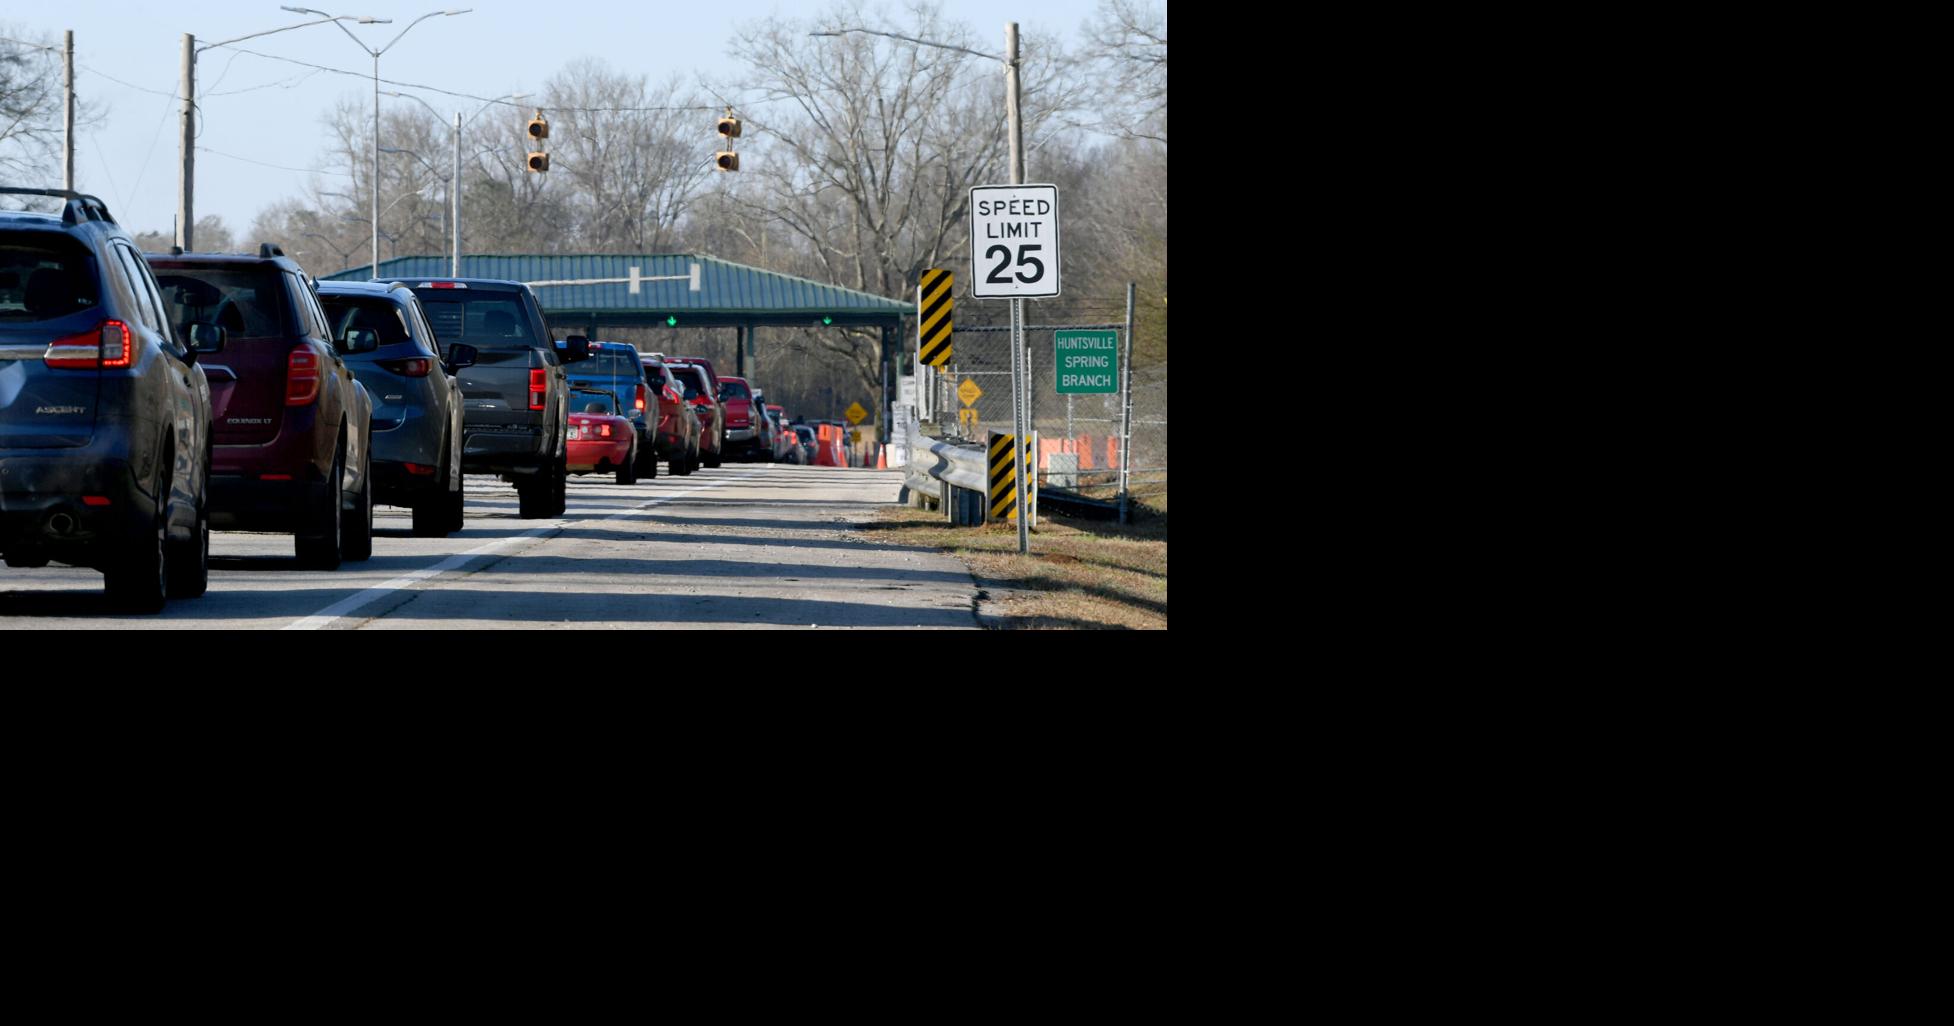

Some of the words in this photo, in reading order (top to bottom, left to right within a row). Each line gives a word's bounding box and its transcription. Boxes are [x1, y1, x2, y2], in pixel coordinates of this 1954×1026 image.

[979, 200, 1050, 216] SPEED
[987, 222, 1042, 238] LIMIT
[985, 244, 1044, 284] 25
[1057, 337, 1114, 349] HUNTSVILLE
[1065, 356, 1109, 368] SPRING
[1062, 375, 1111, 387] BRANCH
[35, 406, 86, 414] ASCENT
